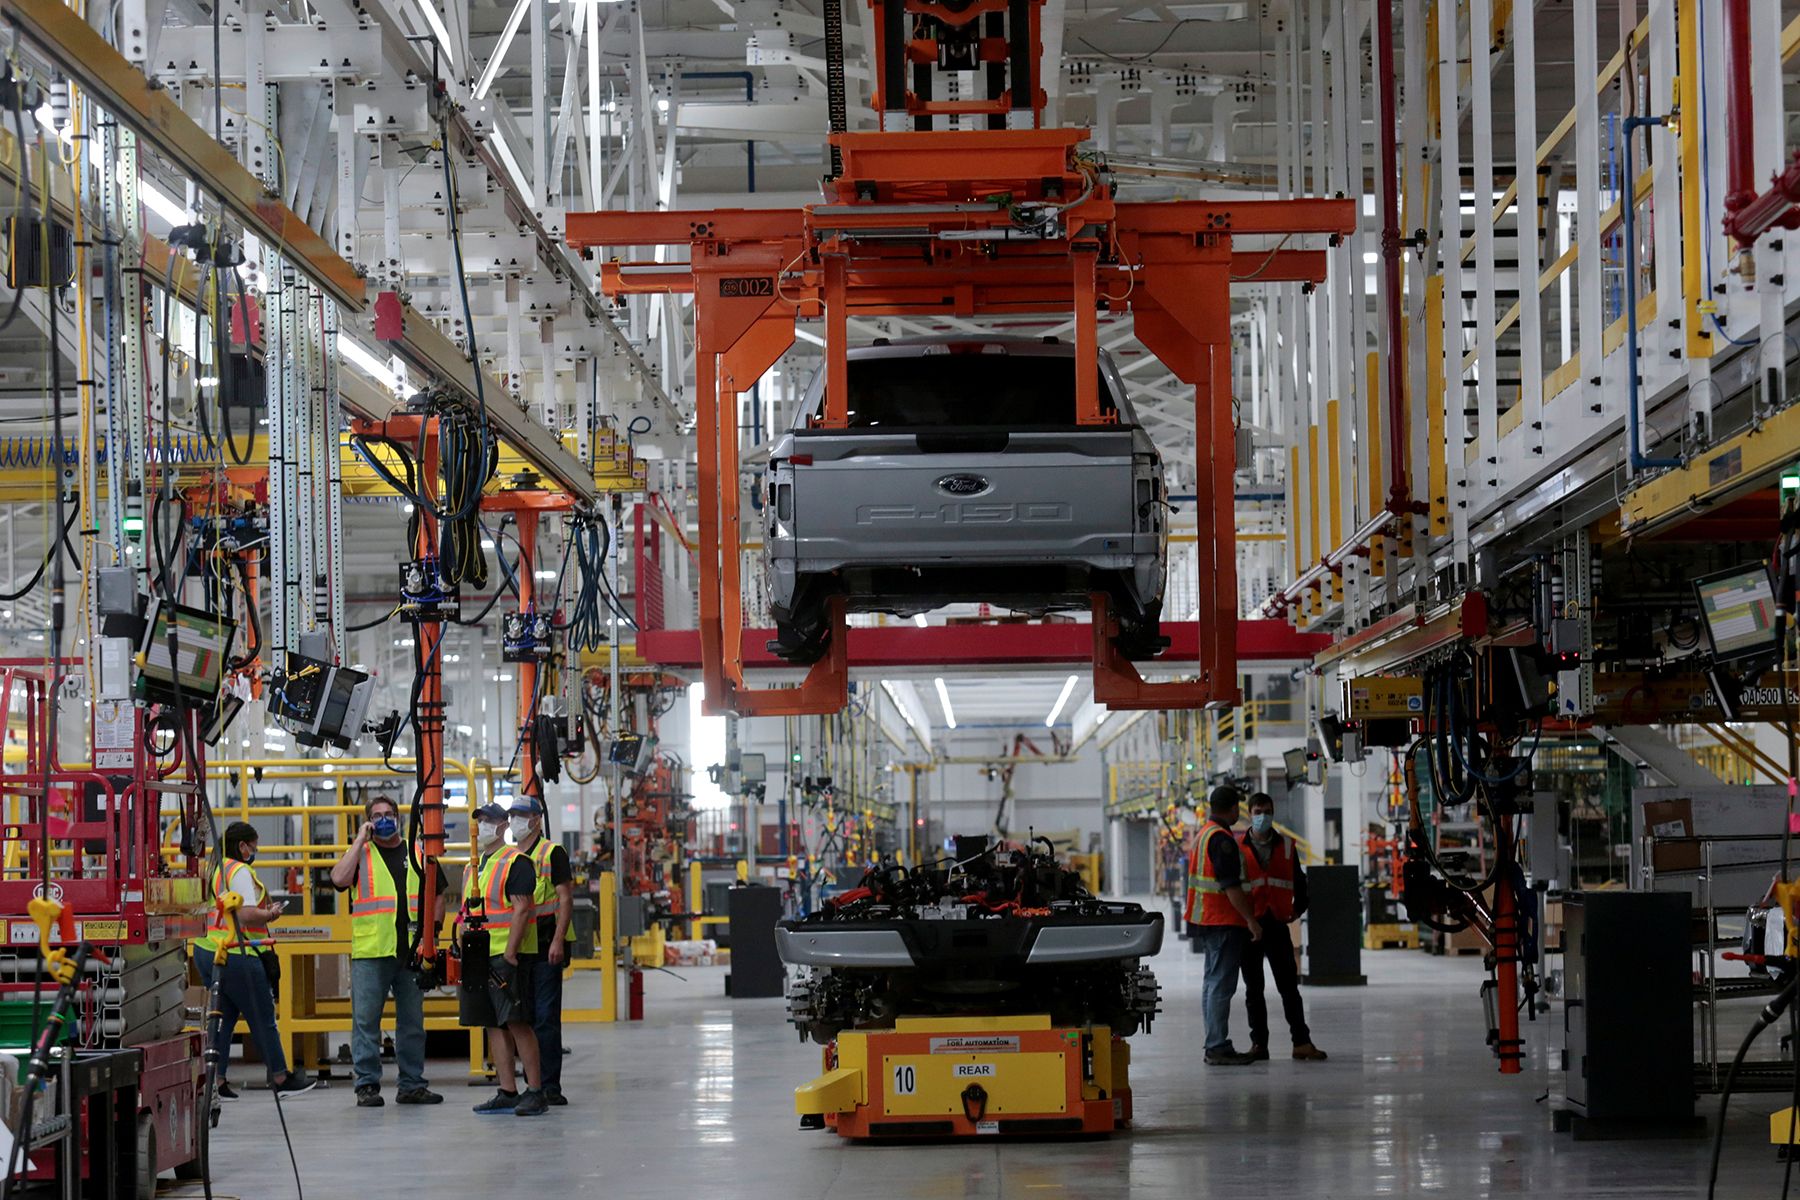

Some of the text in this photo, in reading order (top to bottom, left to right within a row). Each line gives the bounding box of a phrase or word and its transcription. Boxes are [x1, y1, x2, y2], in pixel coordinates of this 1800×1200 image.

[739, 279, 770, 296] 002
[951, 479, 977, 491] Ford
[856, 502, 1072, 524] F-150
[958, 1065, 990, 1075] REAR
[895, 1066, 915, 1093] 10
